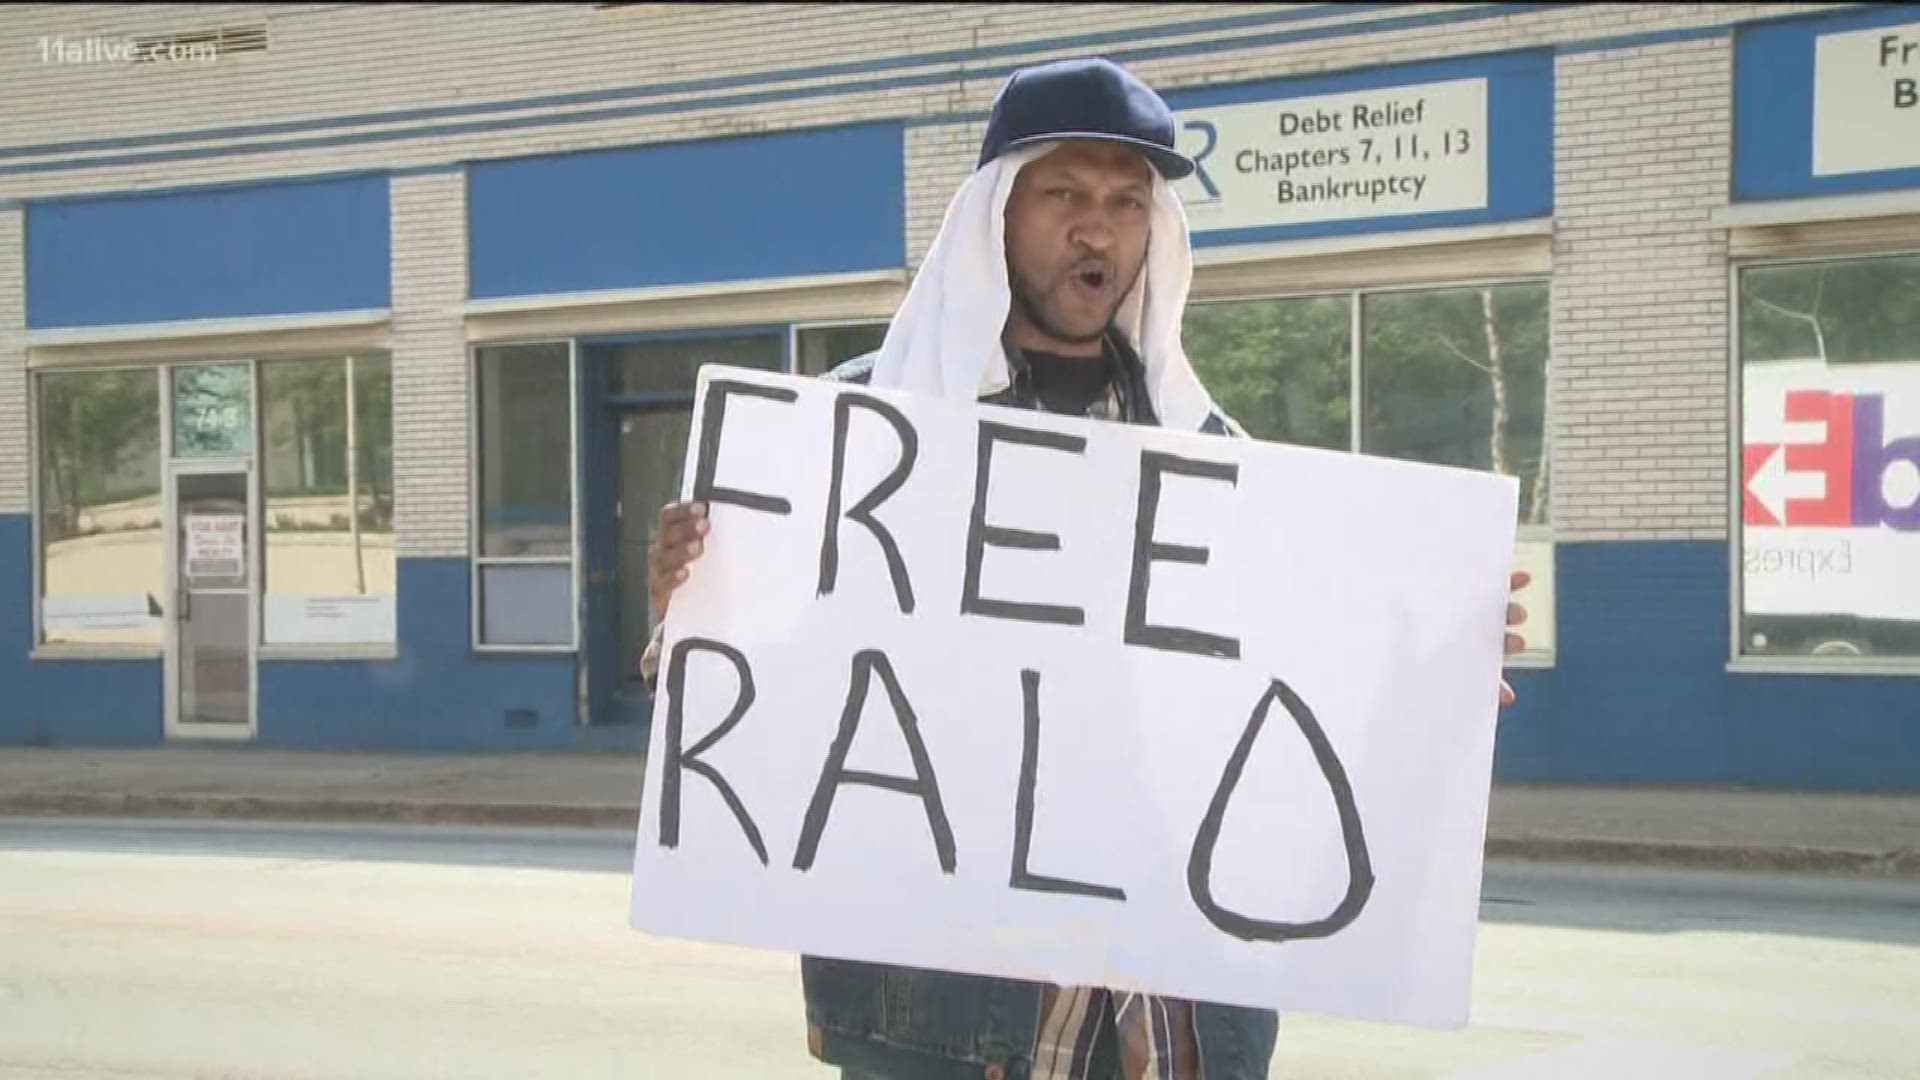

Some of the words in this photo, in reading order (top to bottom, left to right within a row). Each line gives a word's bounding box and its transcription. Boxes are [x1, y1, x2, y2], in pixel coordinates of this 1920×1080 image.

[1880, 36, 1920, 67] Fr
[1279, 108, 1343, 137] Debt
[1352, 98, 1426, 130] Relief
[1234, 146, 1350, 176] Chapters
[1358, 138, 1382, 166] 7,
[1394, 133, 1430, 162] 11,
[1444, 128, 1471, 156] 13
[1277, 174, 1427, 205] Bankruptcy
[692, 379, 1241, 660] FREE
[657, 637, 1376, 943] RALO
